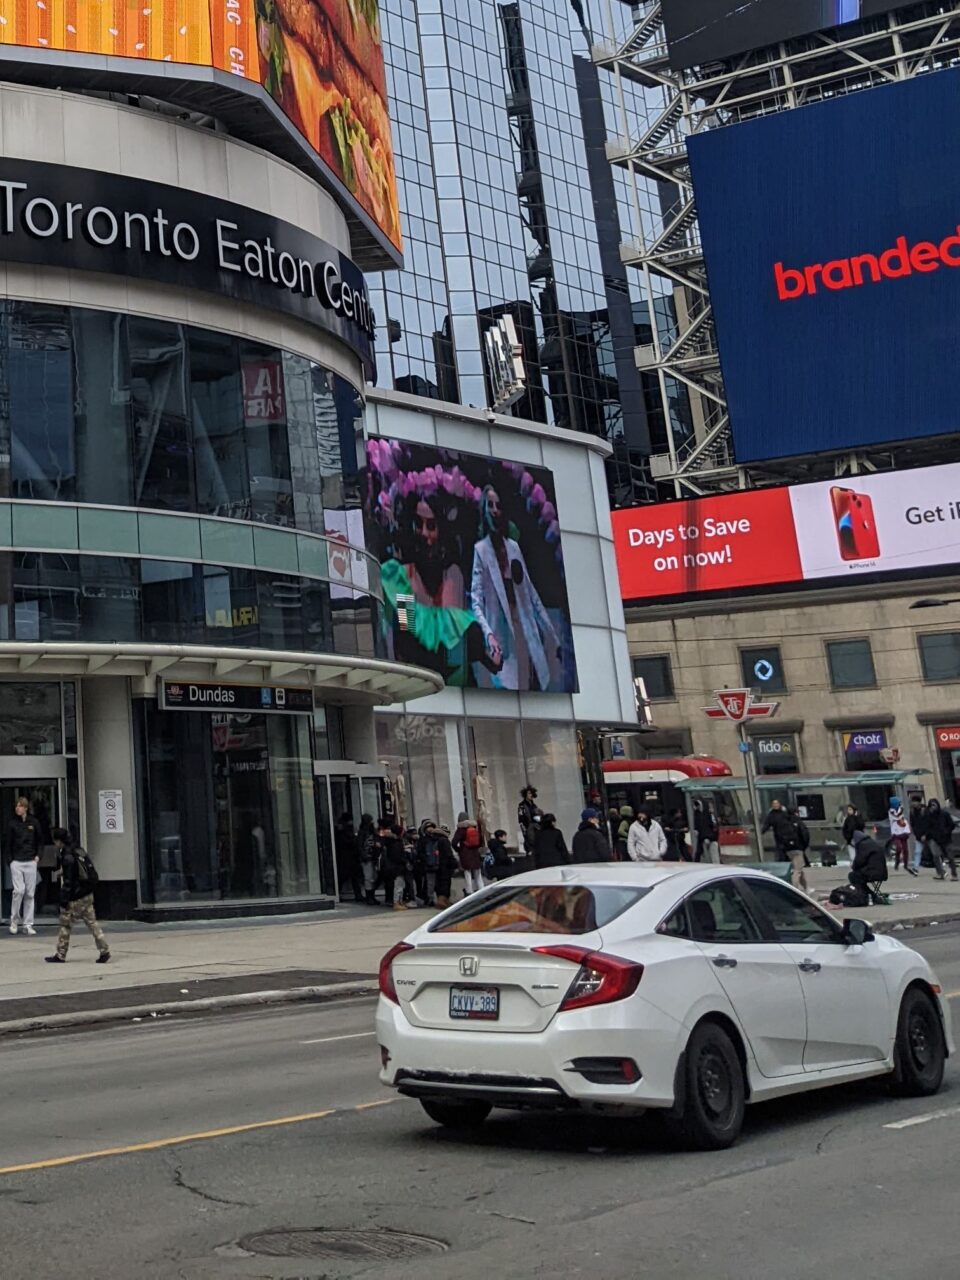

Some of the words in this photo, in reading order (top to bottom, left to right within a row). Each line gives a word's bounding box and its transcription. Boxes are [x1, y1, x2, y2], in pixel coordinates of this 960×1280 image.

[216, 219, 316, 297] Eaton
[774, 224, 960, 301] branded
[905, 506, 945, 525] Get
[629, 528, 675, 549] Days
[679, 522, 699, 540] to
[704, 516, 750, 538] Save
[653, 556, 678, 572] on
[683, 545, 732, 569] now!
[189, 685, 235, 702] Dundas
[758, 740, 781, 753] fido
